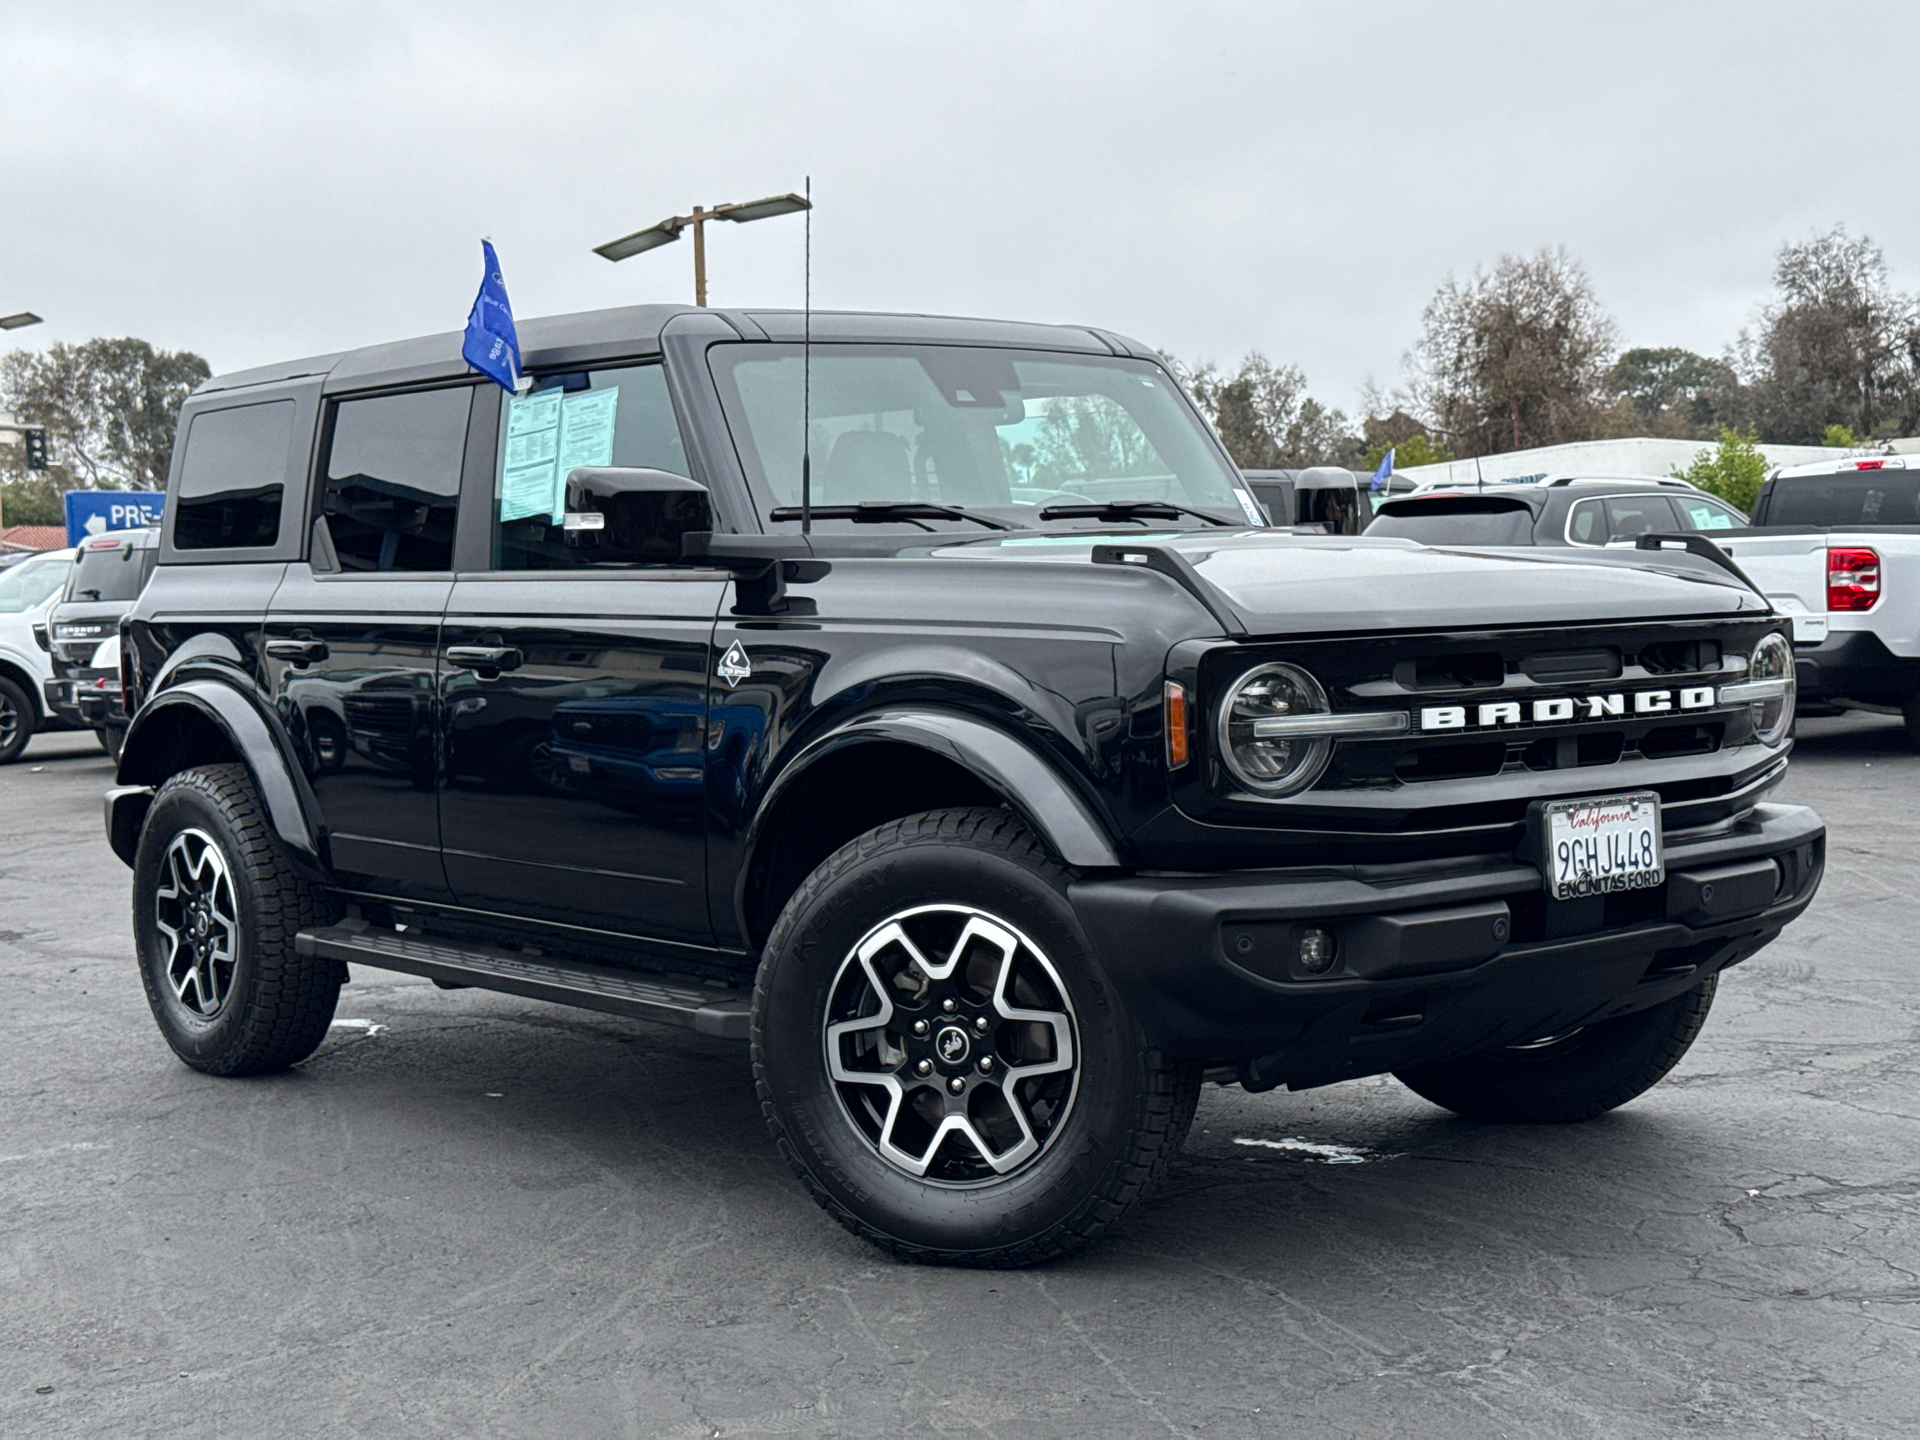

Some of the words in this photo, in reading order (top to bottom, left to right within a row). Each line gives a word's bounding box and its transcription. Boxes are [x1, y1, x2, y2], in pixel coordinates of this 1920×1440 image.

[111, 504, 164, 528] PRE-
[1420, 686, 1716, 731] BRONCO
[1570, 807, 1638, 833] California
[1557, 829, 1654, 881] 9GHJ448
[1558, 874, 1627, 899] ENCINITAS
[1628, 869, 1661, 888] FORD
